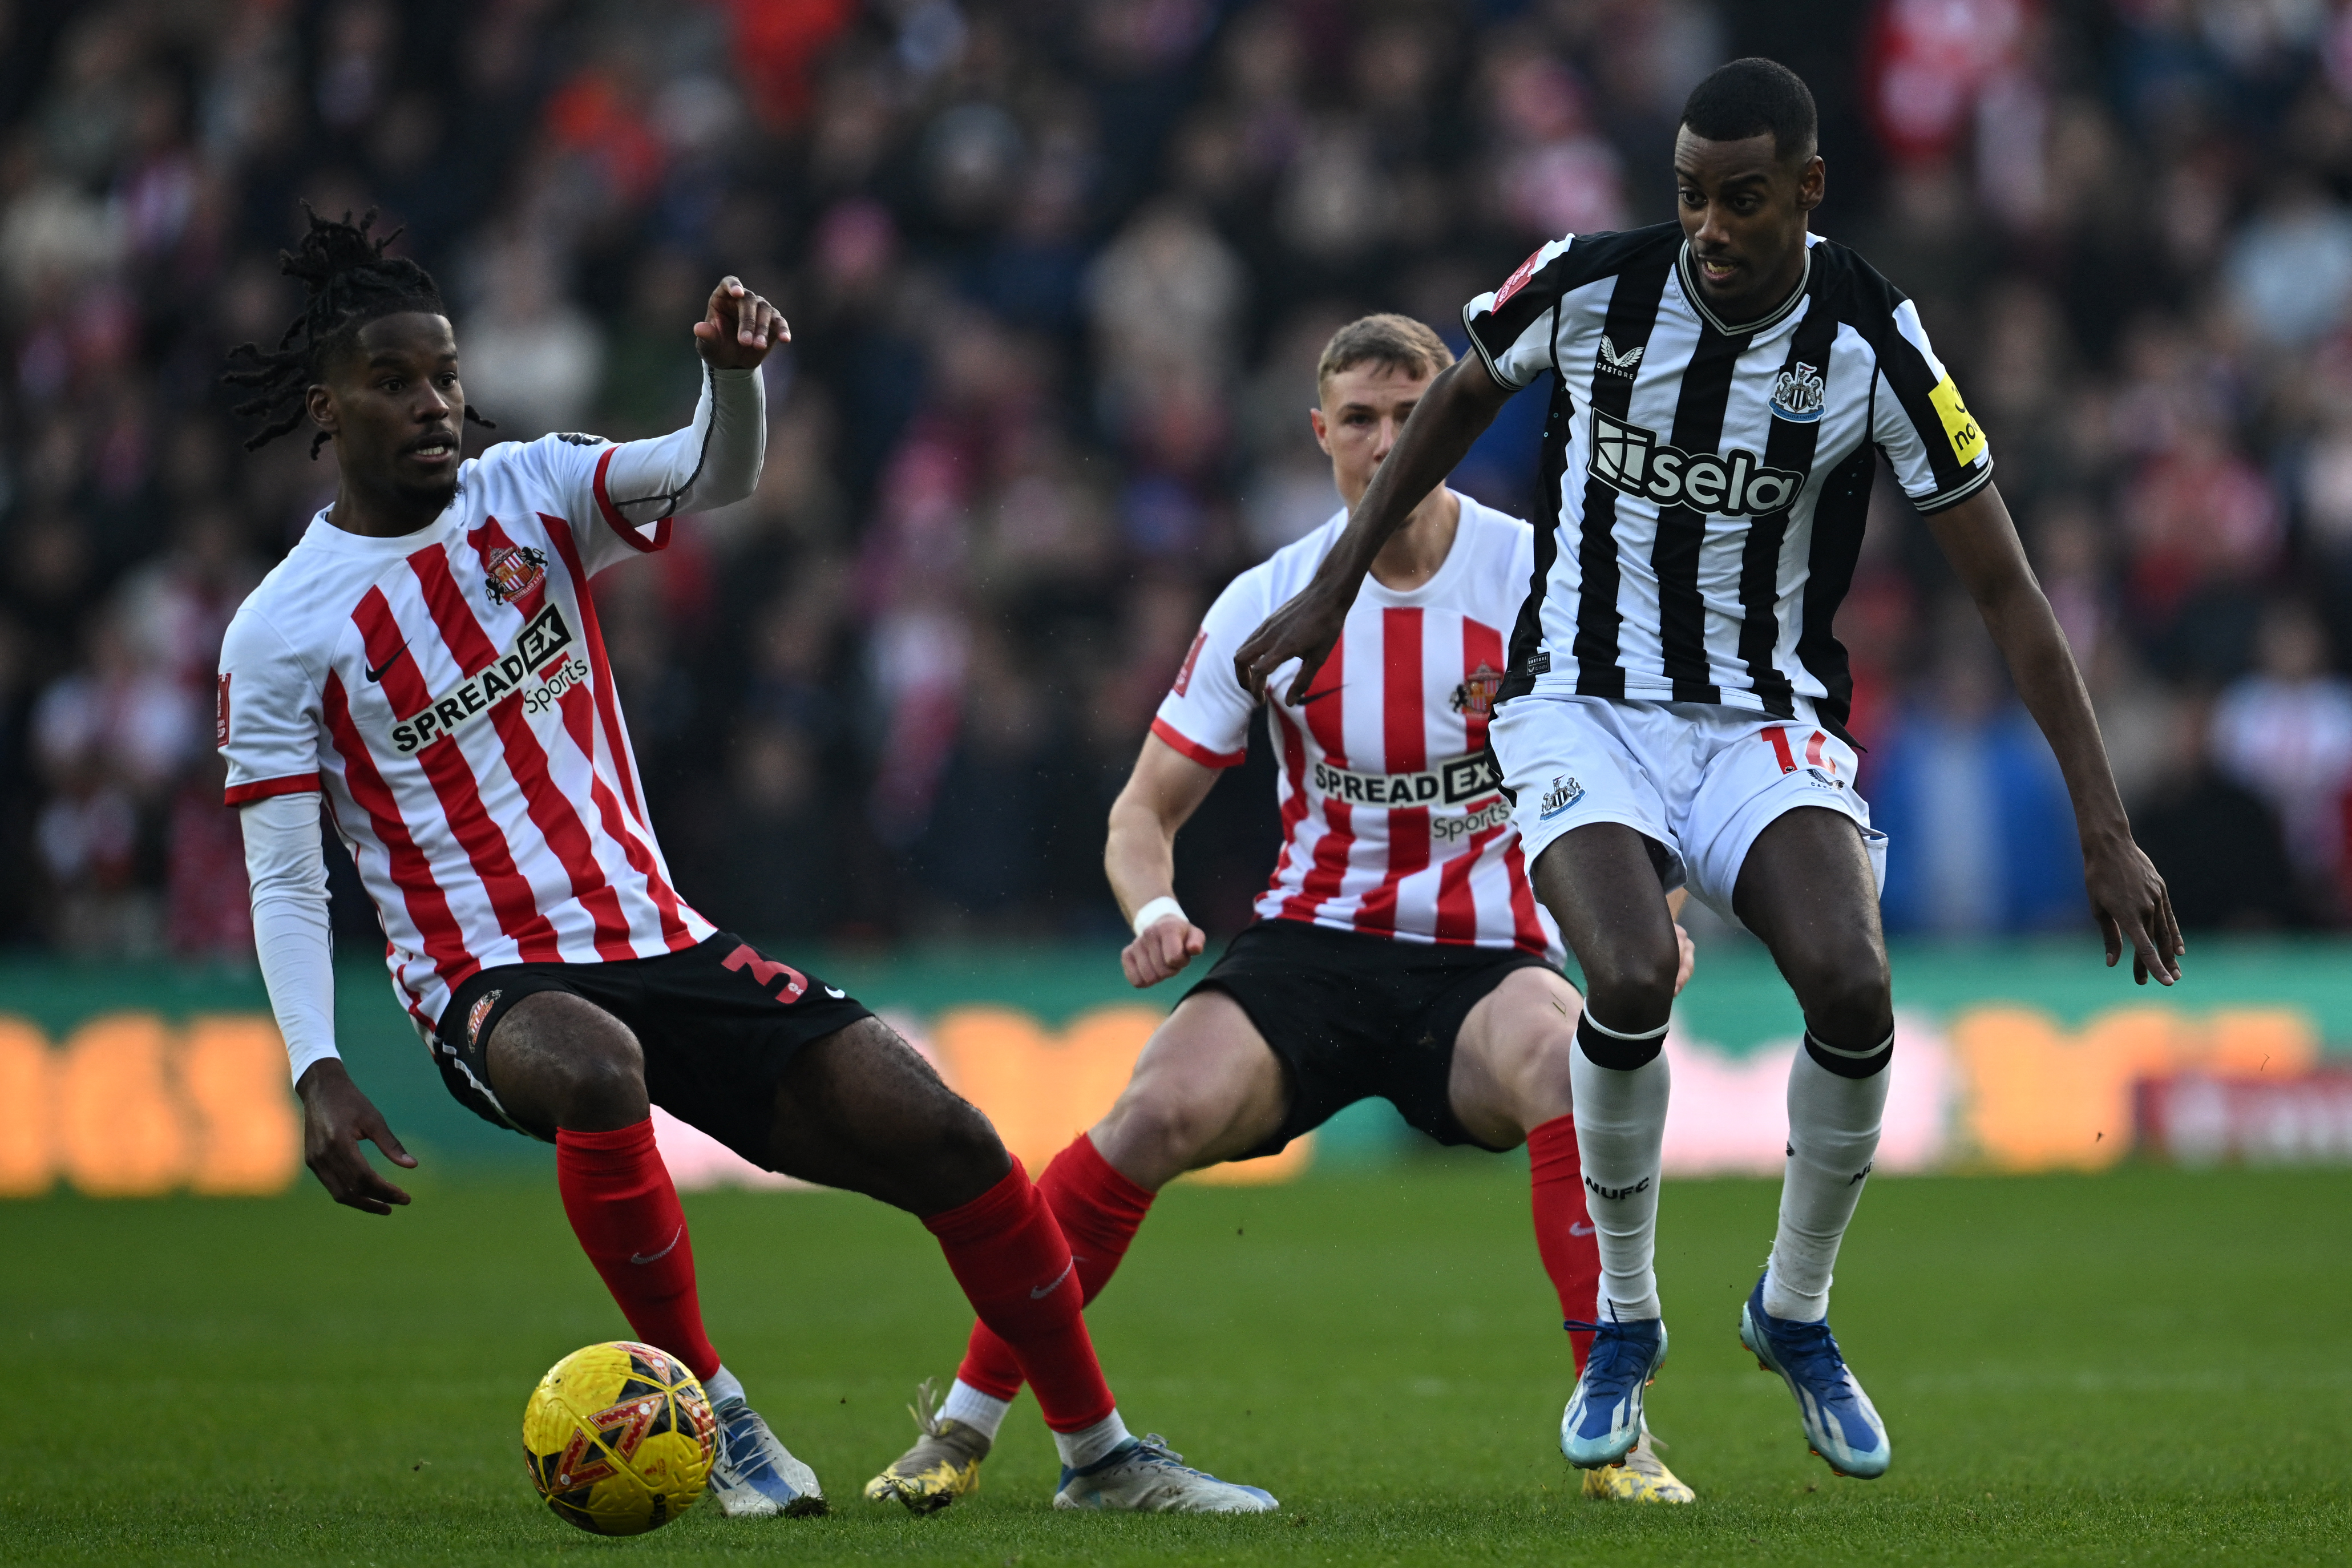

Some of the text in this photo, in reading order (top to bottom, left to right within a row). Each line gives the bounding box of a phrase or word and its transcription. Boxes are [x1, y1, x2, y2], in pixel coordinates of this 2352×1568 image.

[1597, 362, 1634, 379] CASTORE
[1776, 408, 1799, 419] NEWCASTLE
[1648, 454, 1793, 510] sela
[510, 583, 535, 602] SUNDERLAND
[524, 660, 588, 713] Sports
[1433, 805, 1509, 842] Sports
[721, 944, 808, 1004] 3
[1586, 1176, 1649, 1199] NUFC
